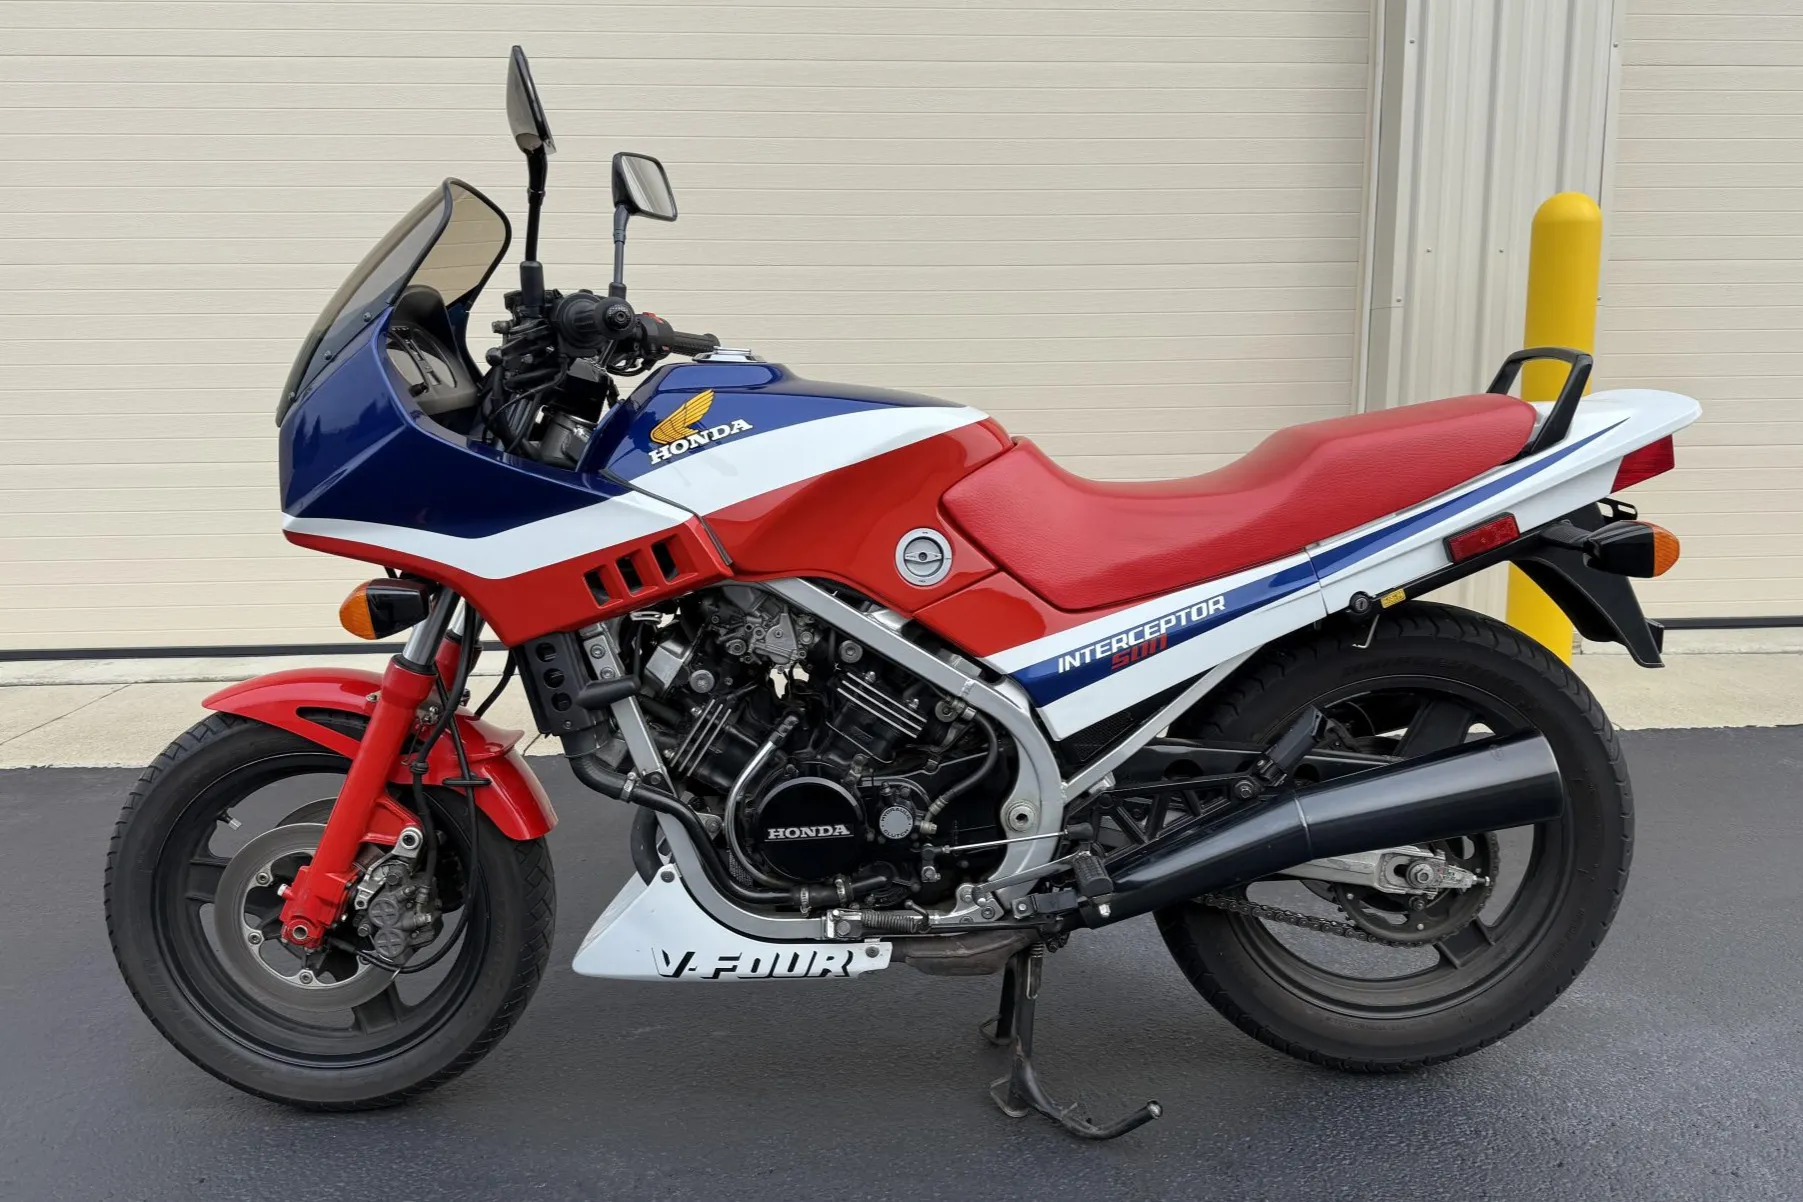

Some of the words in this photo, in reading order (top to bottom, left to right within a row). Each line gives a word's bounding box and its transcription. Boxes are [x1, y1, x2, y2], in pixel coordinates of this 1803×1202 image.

[649, 419, 753, 464] HONDA
[1057, 595, 1226, 674] INTERCEPTOR
[1111, 633, 1168, 671] 500
[881, 807, 912, 821] HYDRAULIC
[767, 824, 851, 839] HONDA
[883, 829, 909, 838] CLUTCH
[652, 947, 854, 979] V-FOUR
